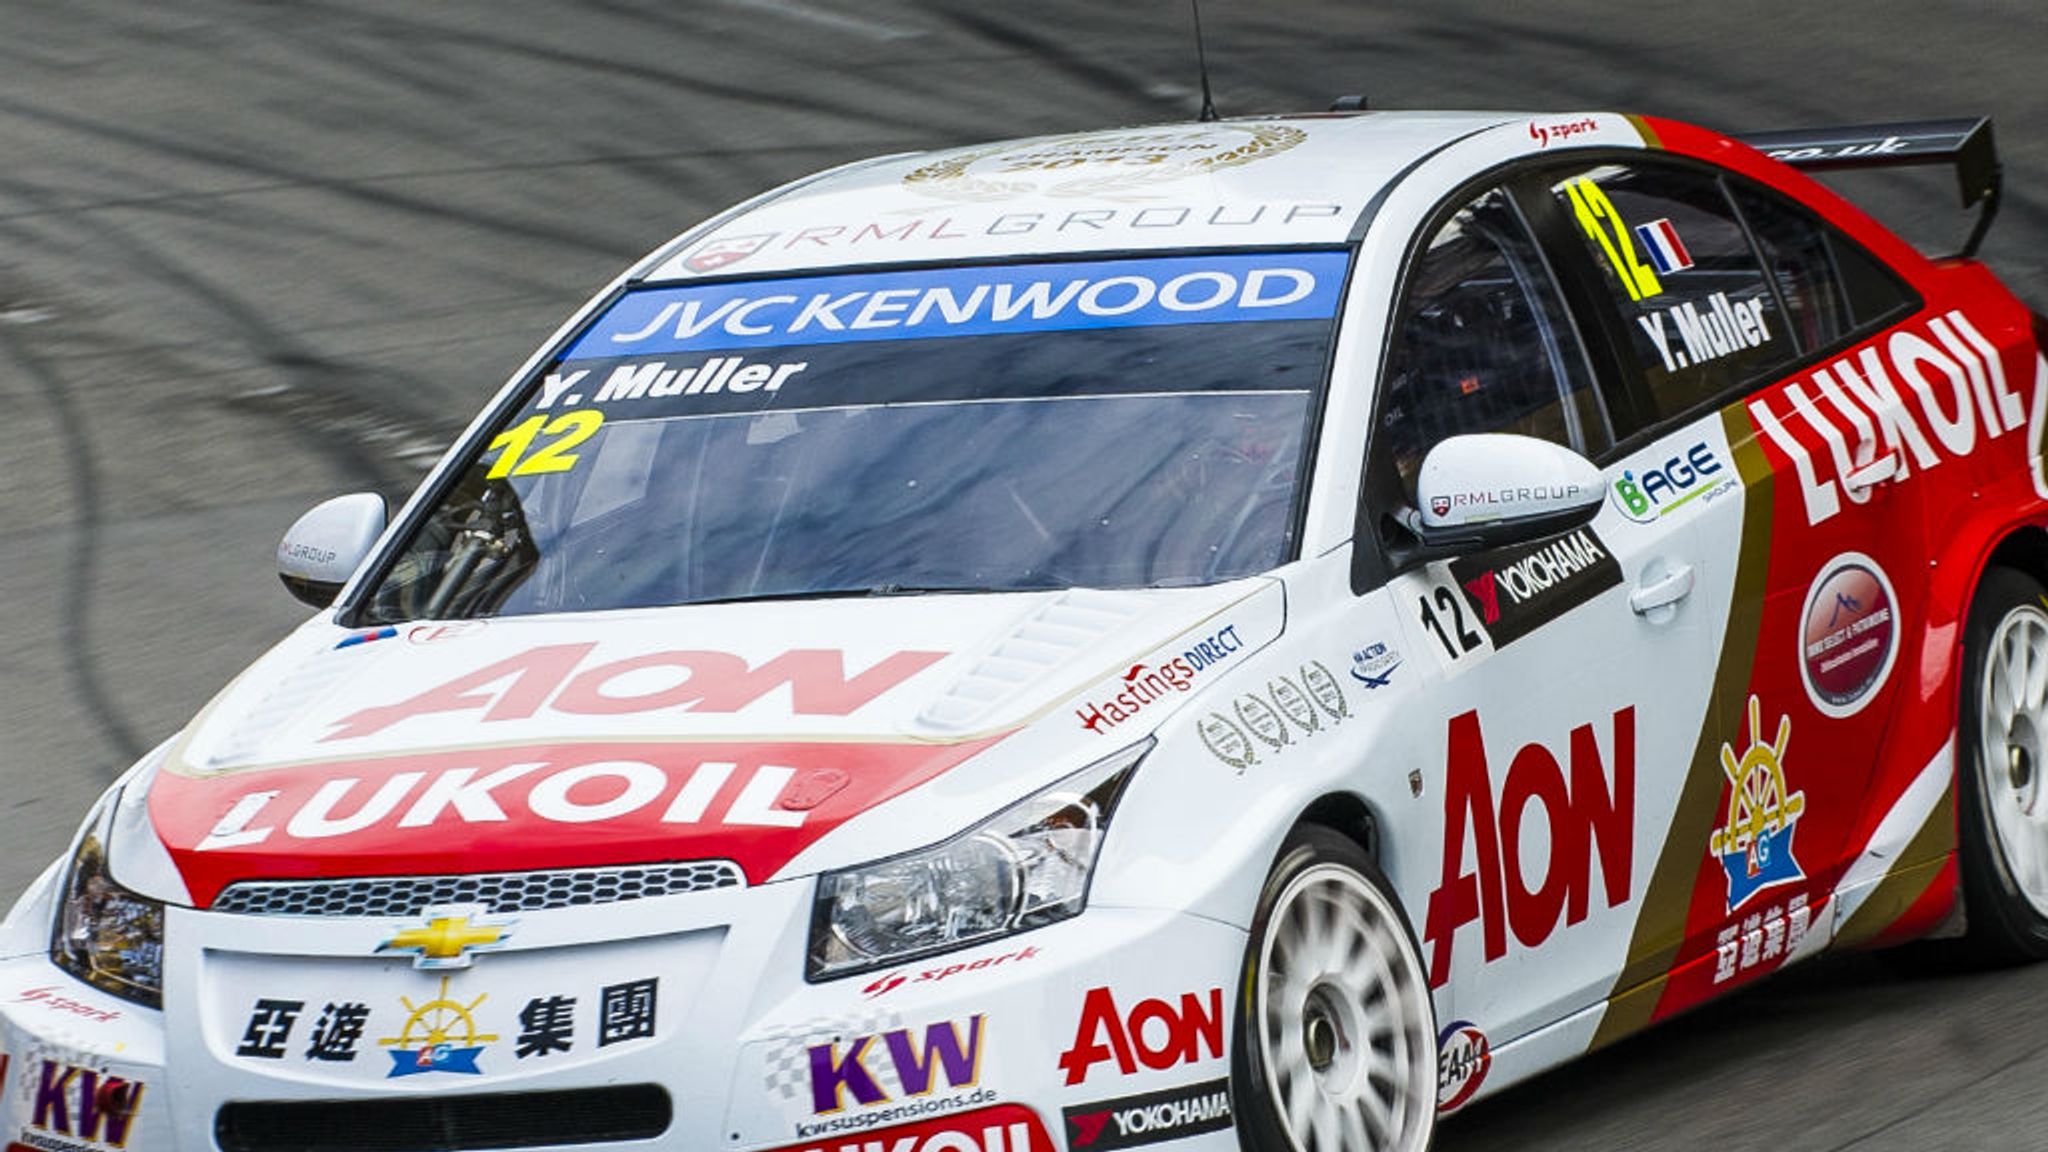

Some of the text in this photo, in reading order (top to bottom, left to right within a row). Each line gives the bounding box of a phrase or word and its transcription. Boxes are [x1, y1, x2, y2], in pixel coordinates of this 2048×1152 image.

[1564, 176, 1663, 302] 12
[594, 356, 808, 402] Muller
[1748, 309, 2027, 527] LUKOIL
[486, 409, 605, 480] 12
[1453, 485, 1581, 508] RMLGROUP
[1495, 529, 1606, 604] YOKOHAMA
[1420, 585, 1483, 660] 12
[314, 641, 954, 743] AON
[194, 761, 811, 852] LUKOIL
[1424, 704, 1636, 990] AON
[912, 945, 1042, 982] spark
[806, 1012, 988, 1115] KW
[1057, 986, 1224, 1087] AON
[31, 1059, 146, 1149] KW
[796, 1088, 998, 1139] kwsuspensions.de
[1112, 1091, 1232, 1136] YOKOHAMA
